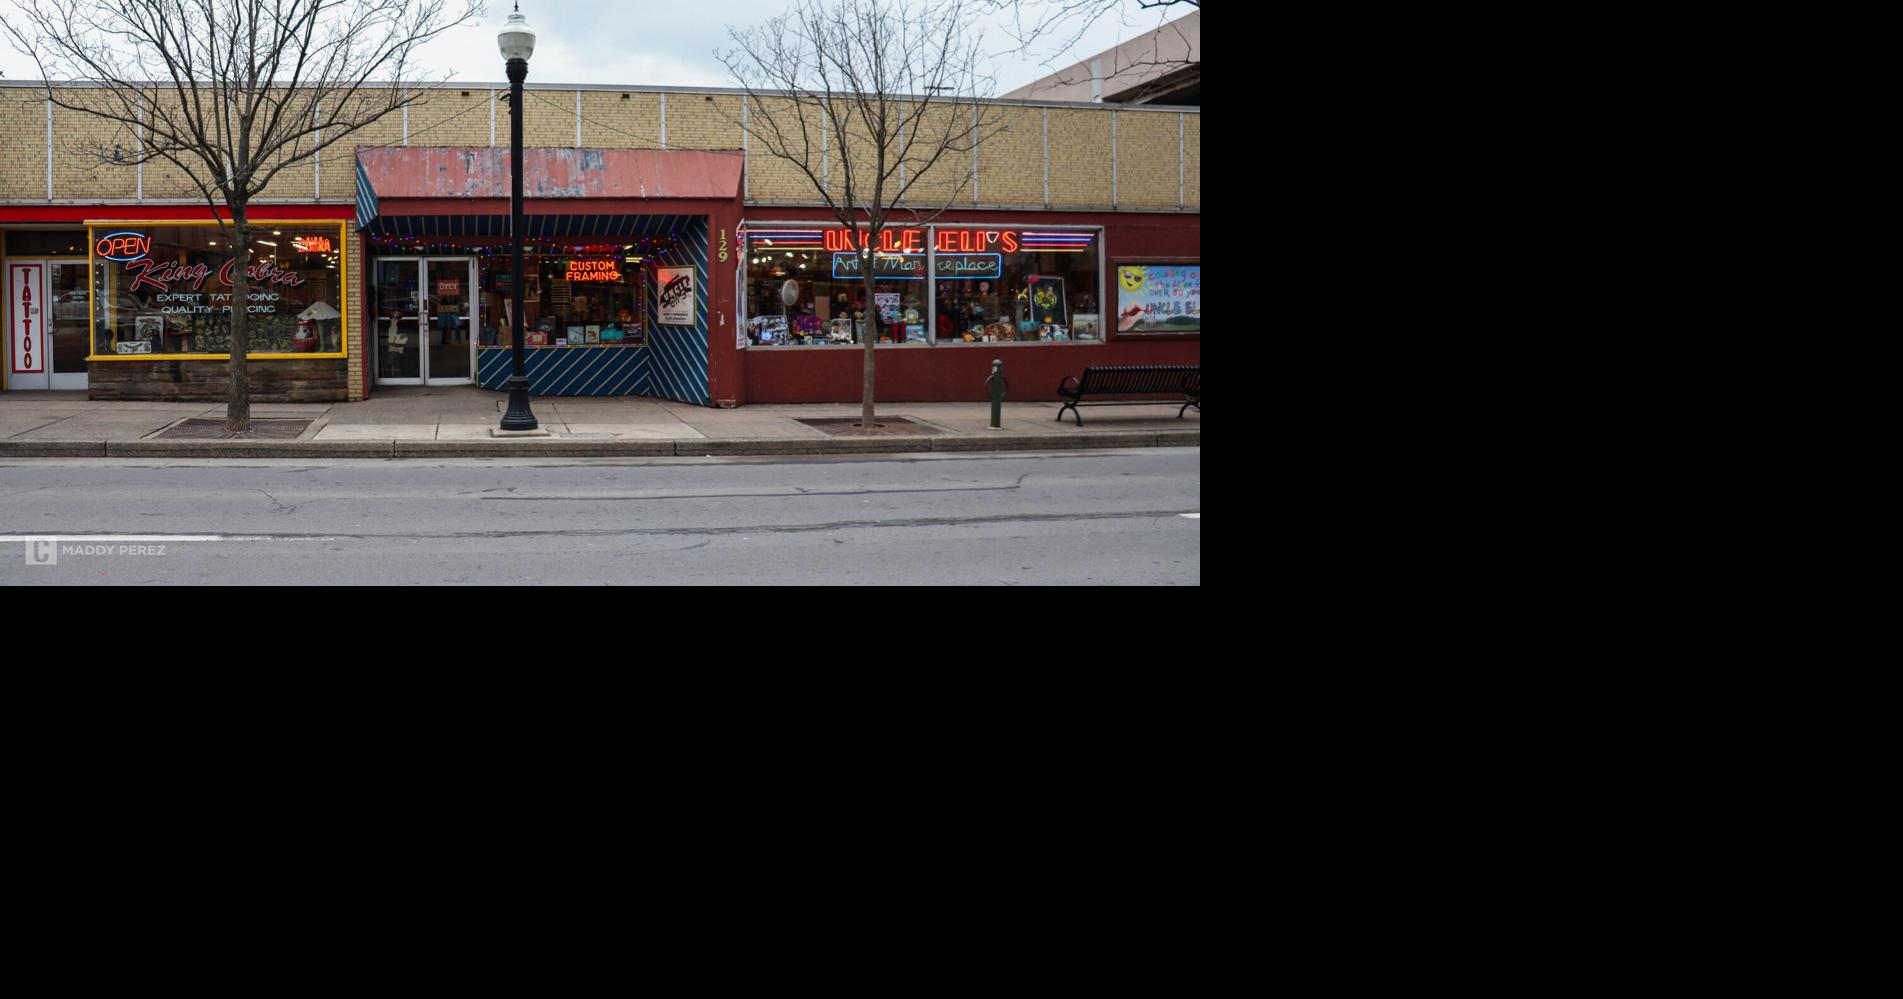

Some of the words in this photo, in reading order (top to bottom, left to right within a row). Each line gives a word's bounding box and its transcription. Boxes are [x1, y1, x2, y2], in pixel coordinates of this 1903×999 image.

[96, 236, 151, 256] OPEN
[719, 229, 728, 263] 129
[826, 230, 921, 252] UNCLE
[938, 231, 1018, 253] ELI'S
[126, 258, 213, 292] King
[566, 271, 618, 281] FRAMING
[569, 261, 615, 271] CUSTOM
[156, 293, 202, 302] EXPERT
[211, 293, 280, 302] TATOING
[22, 268, 32, 369] TATTOO
[161, 305, 214, 314] QUALITY
[222, 305, 276, 313] PICING
